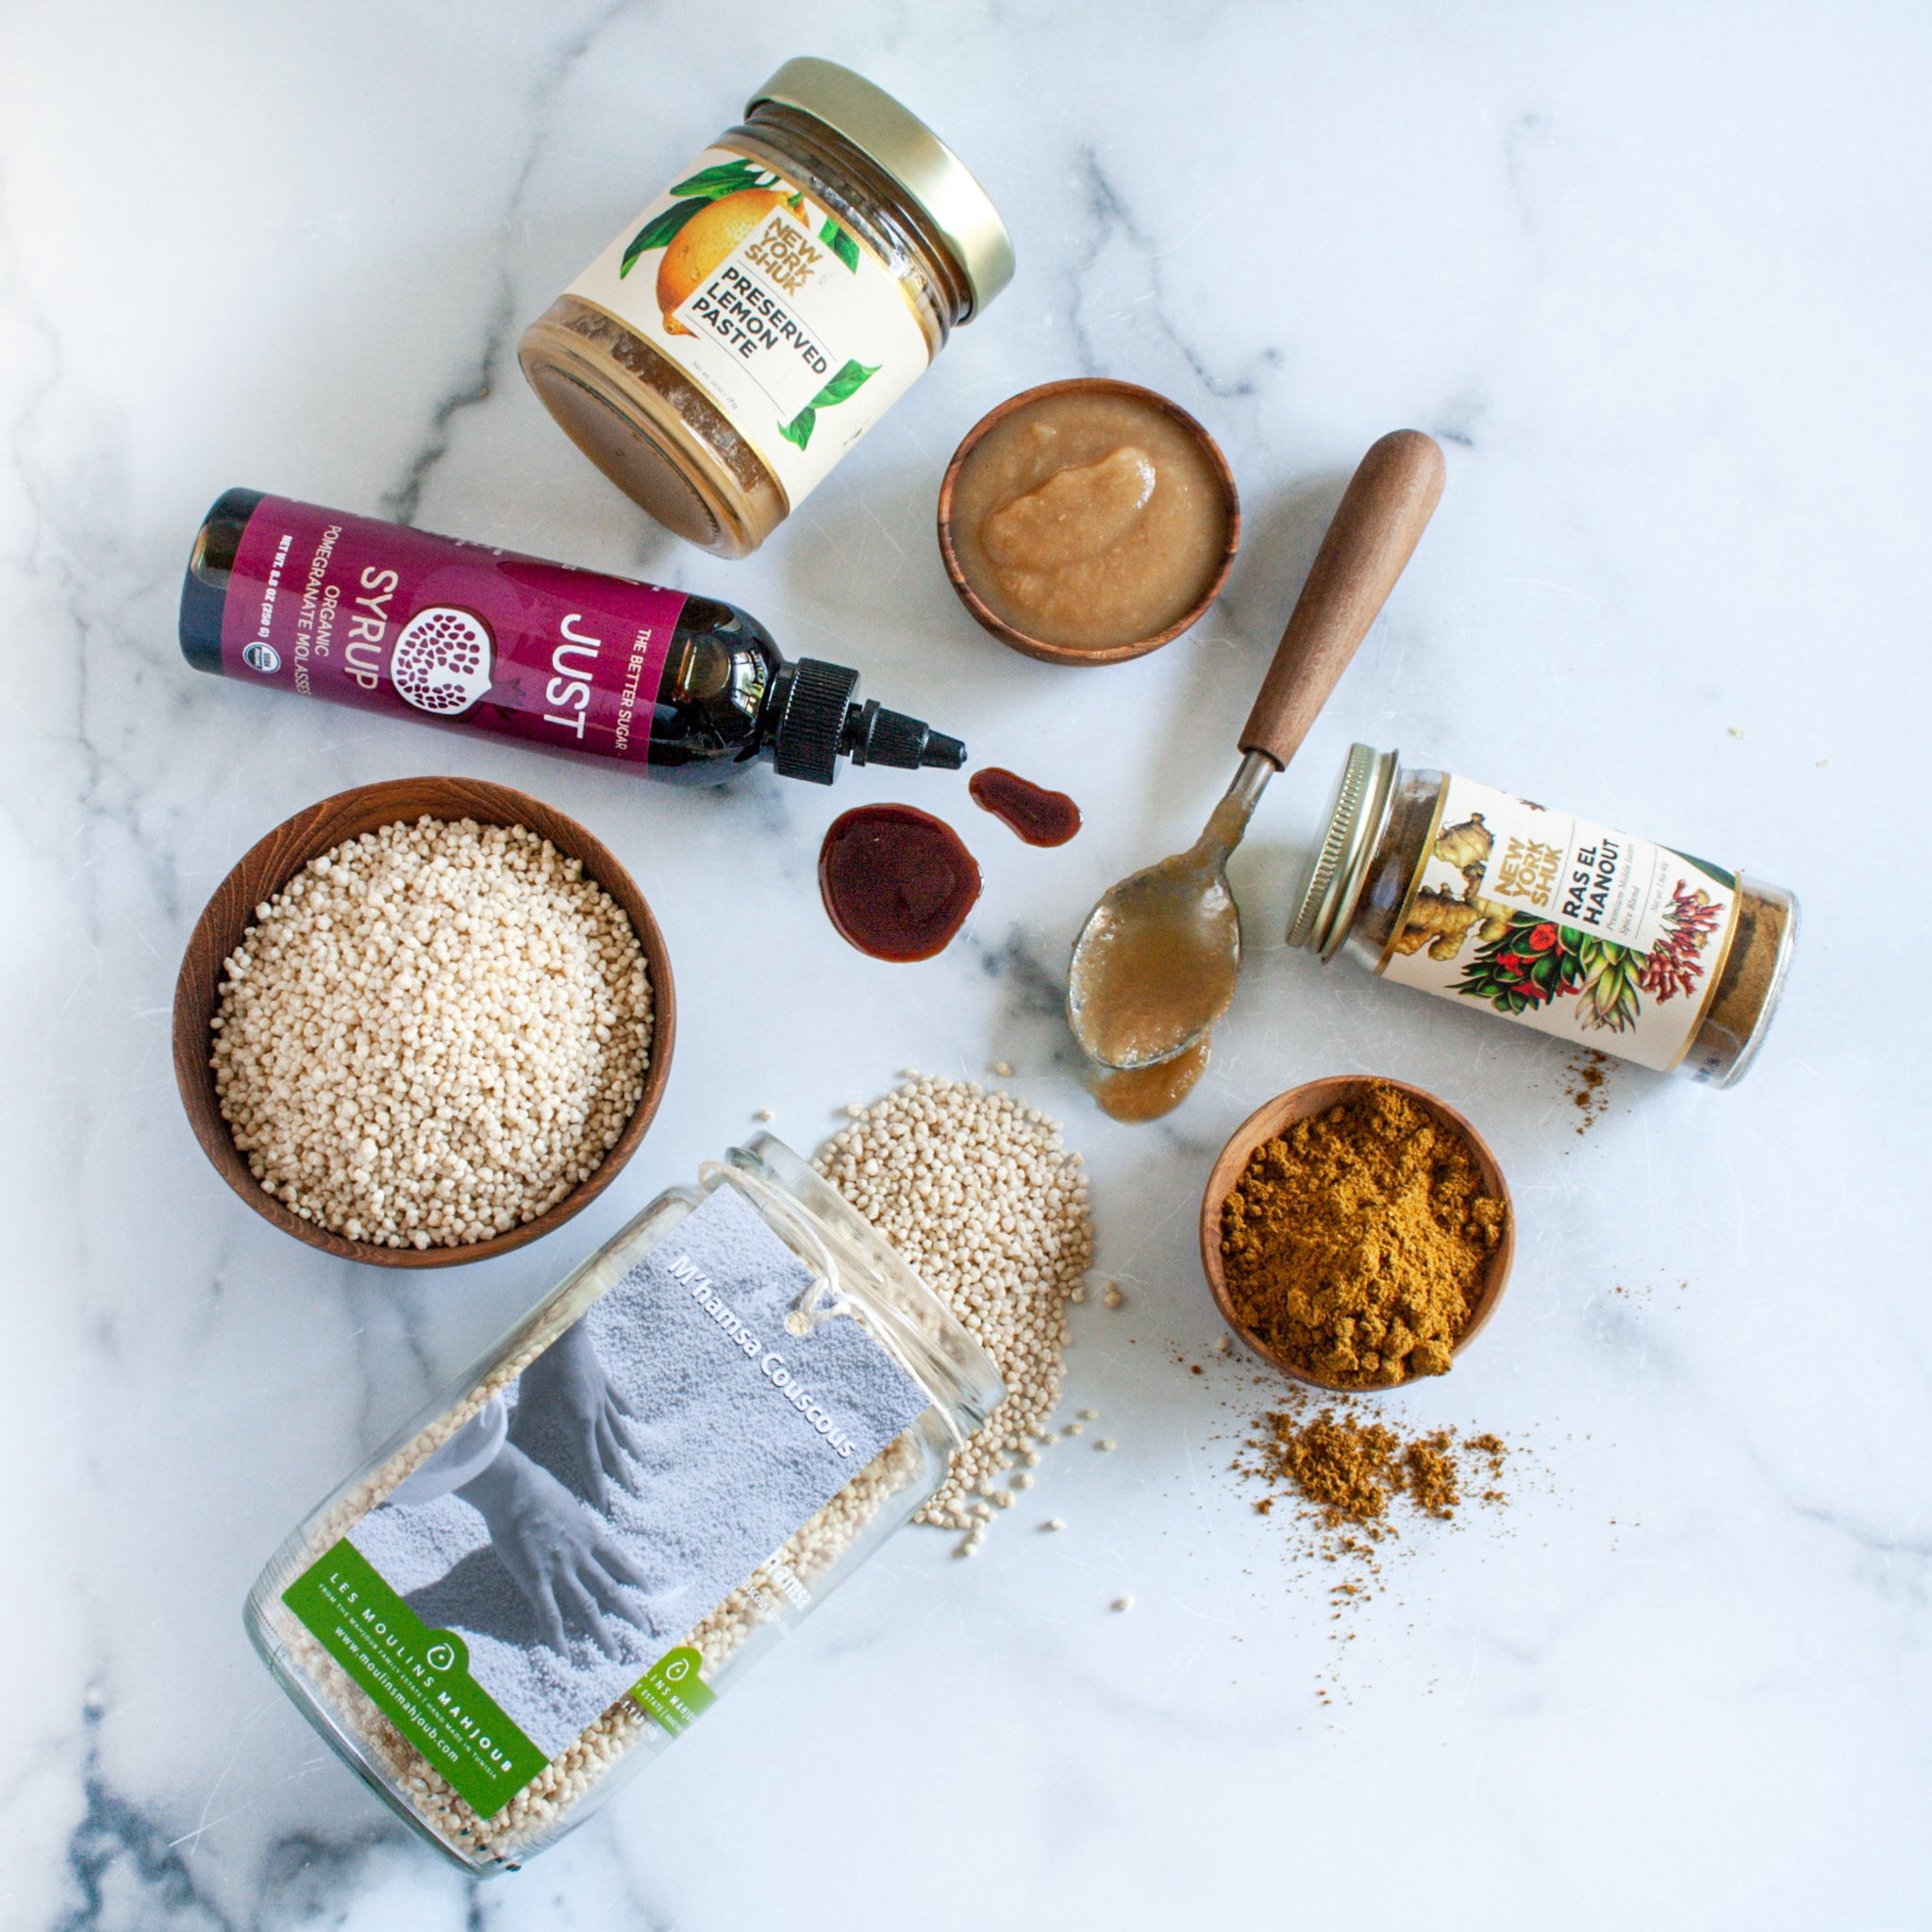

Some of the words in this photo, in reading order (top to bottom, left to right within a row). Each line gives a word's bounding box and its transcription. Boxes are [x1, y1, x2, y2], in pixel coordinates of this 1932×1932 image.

[742, 241, 803, 298] SHUK
[756, 228, 815, 285] YORK
[767, 216, 824, 266] NEW
[691, 296, 758, 358] PASTE
[705, 280, 778, 350] LEMON
[721, 265, 828, 374] PRESERVED
[272, 553, 287, 569] WT.
[277, 534, 291, 552] NET
[264, 588, 275, 601] OZ
[267, 570, 281, 587] 8.8
[296, 524, 341, 630] POMEGRANATE
[258, 602, 273, 626] (250
[314, 585, 340, 657] ORGANIC
[343, 566, 398, 689] SYRUP
[632, 629, 651, 653] THE
[294, 632, 310, 695] MOLASSES
[542, 613, 601, 739] JUST
[621, 655, 643, 708] BETTER
[614, 709, 631, 750] SUGAR
[1493, 835, 1524, 895] NEW
[1510, 839, 1544, 897] YORK
[1529, 844, 1562, 907] SHUK
[1561, 871, 1590, 918] RAS
[1577, 846, 1597, 866] EL
[1582, 838, 1618, 924] HANOUT
[1618, 912, 1632, 936] Spice
[1626, 885, 1639, 909] Blend
[756, 1348, 856, 1459] Couscous
[316, 1582, 337, 1604] FROM
[335, 1603, 349, 1618] THE
[376, 1649, 400, 1674] FAMILY
[399, 1674, 423, 1698] ESTATE
[425, 1702, 444, 1723] HAND
[444, 1723, 462, 1742] MADE
[462, 1741, 472, 1752] IN
[471, 1752, 497, 1779] TUNISIA
[328, 1572, 358, 1603] LES
[360, 1607, 435, 1688] MOULINS
[437, 1690, 513, 1773] MAHJOUB
[332, 1624, 460, 1762] www.moulinsmahjoub.com
[640, 1688, 663, 1712] ESTATE
